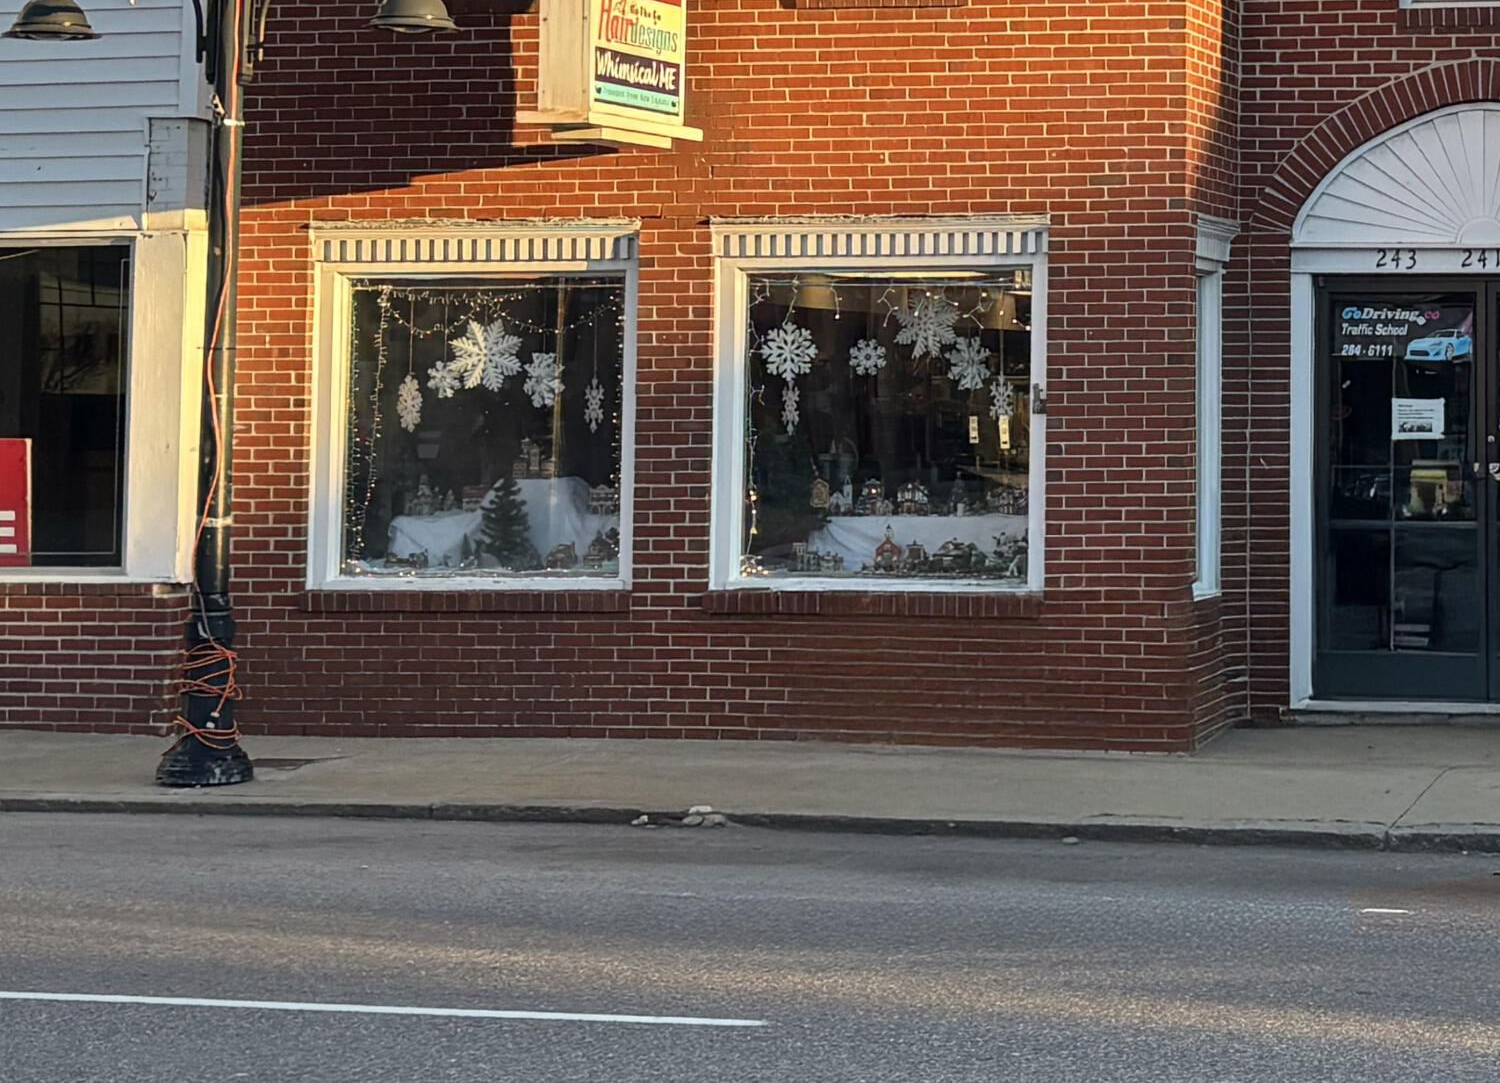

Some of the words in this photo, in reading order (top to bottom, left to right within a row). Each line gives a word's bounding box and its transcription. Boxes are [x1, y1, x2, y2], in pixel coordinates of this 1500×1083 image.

[596, 50, 659, 87] Whimsical
[659, 63, 677, 91] ME
[1376, 248, 1418, 269] 243
[1461, 249, 1500, 269] 241
[1341, 323, 1374, 335] Traffic
[1374, 323, 1409, 336] School
